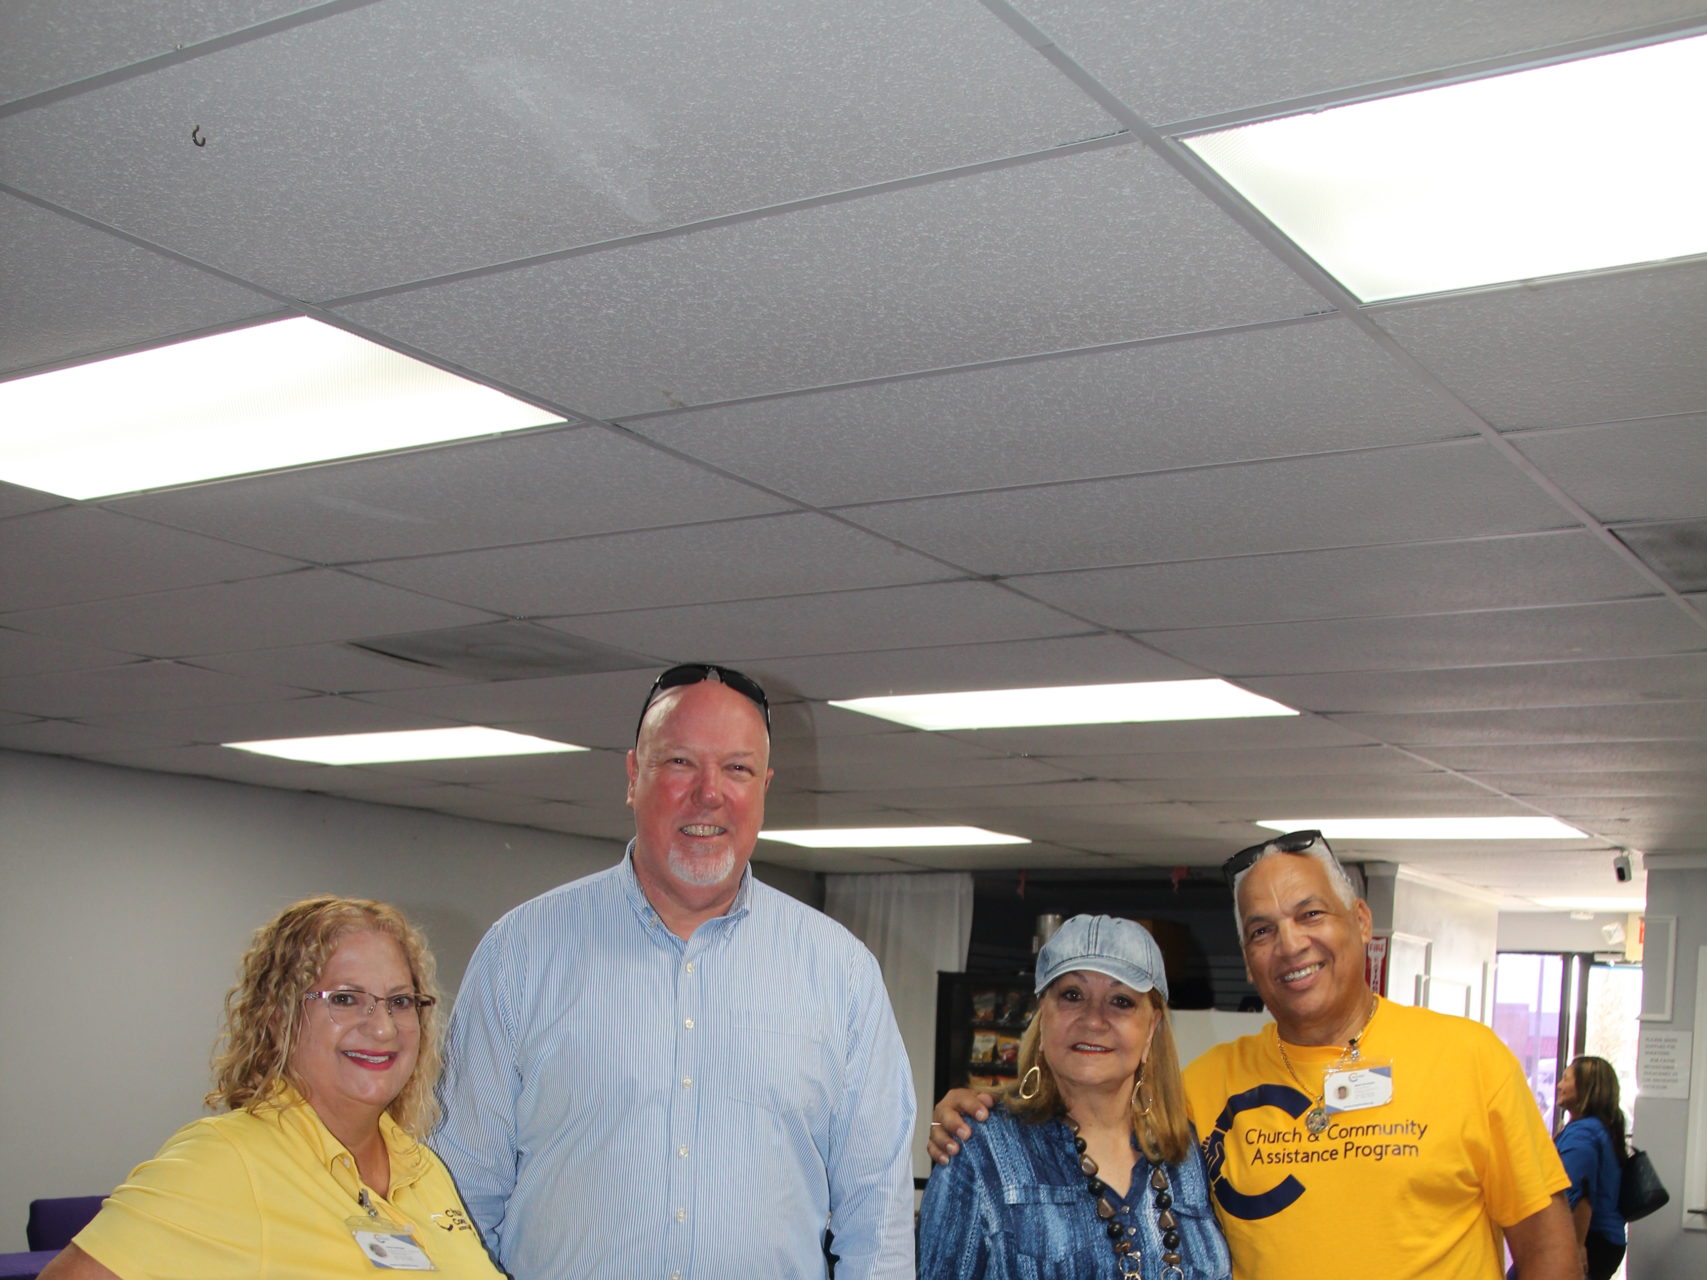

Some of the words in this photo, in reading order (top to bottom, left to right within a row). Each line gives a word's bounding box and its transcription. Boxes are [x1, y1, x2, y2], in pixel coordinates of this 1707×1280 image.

[1245, 1127, 1302, 1145] Church
[1307, 1132, 1320, 1142] &
[1327, 1120, 1428, 1141] Community
[1251, 1147, 1338, 1166] Assistance
[1343, 1141, 1419, 1162] Program
